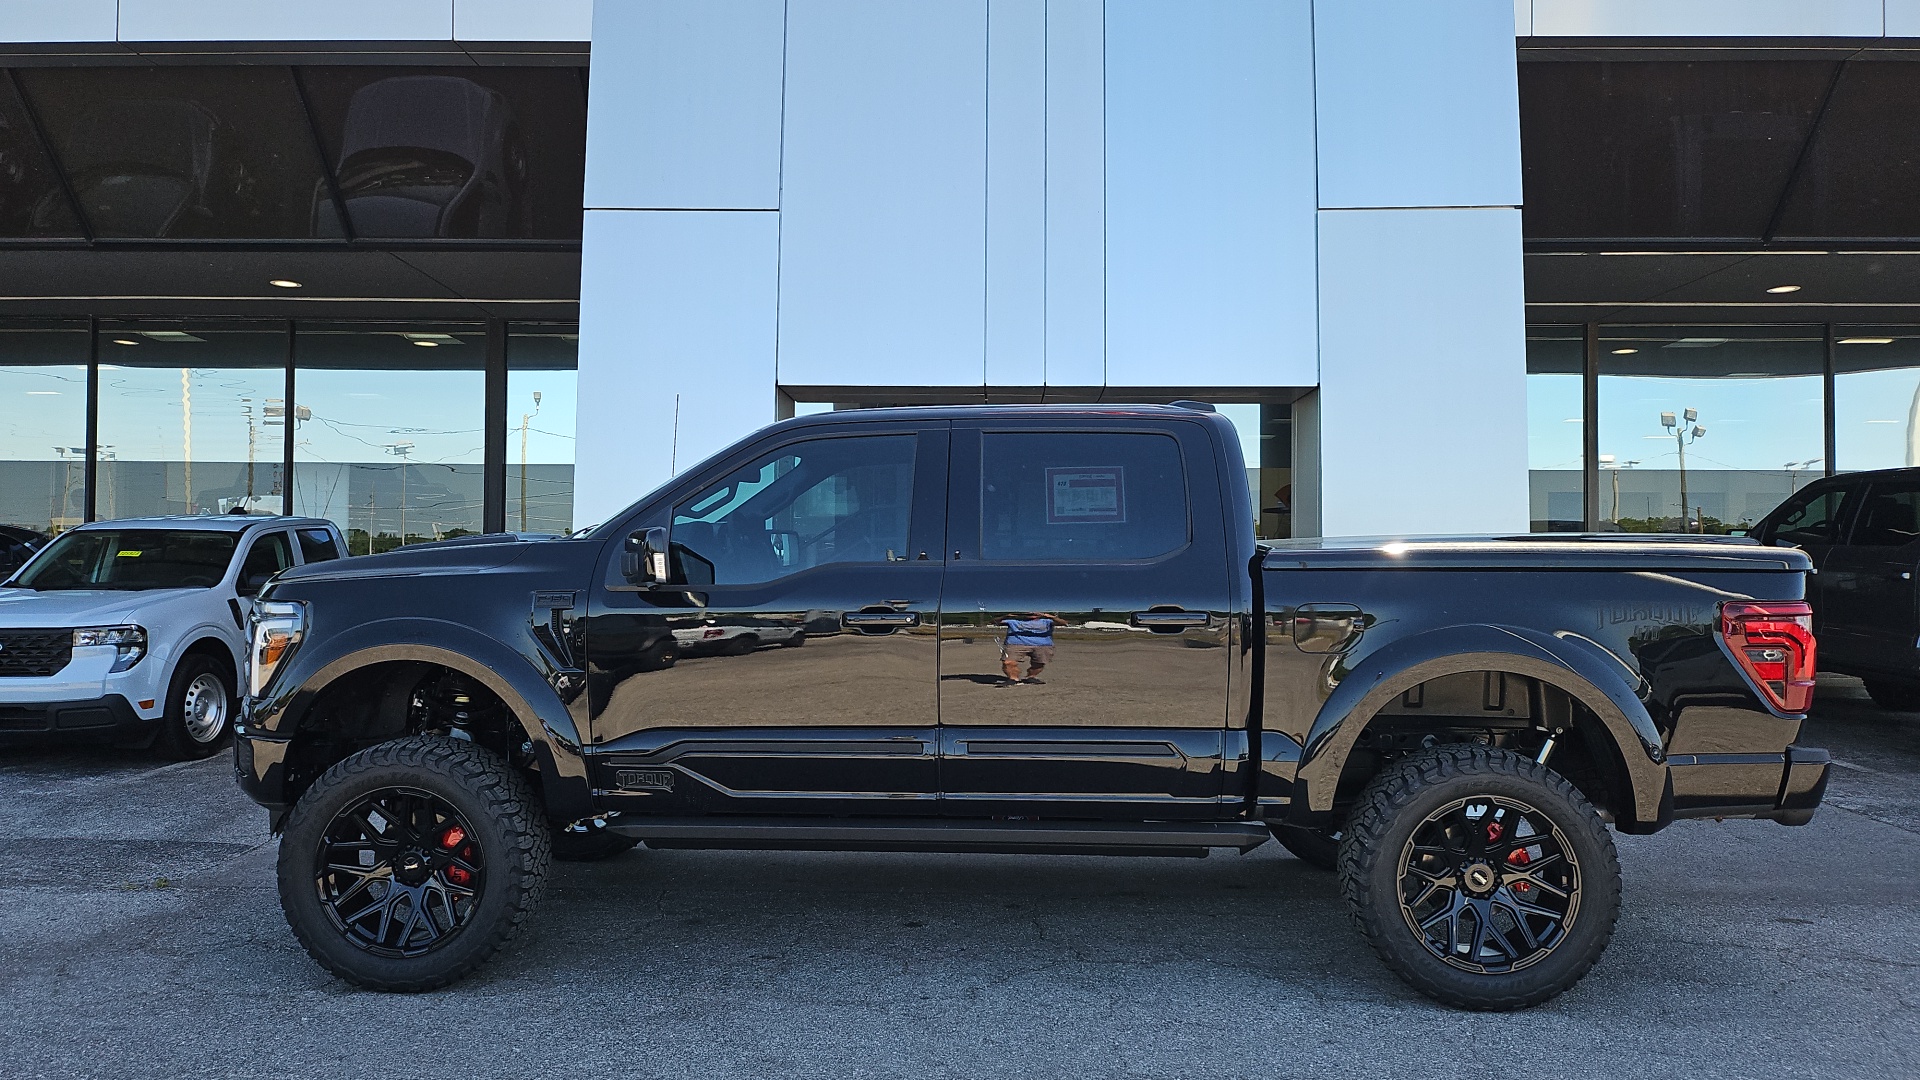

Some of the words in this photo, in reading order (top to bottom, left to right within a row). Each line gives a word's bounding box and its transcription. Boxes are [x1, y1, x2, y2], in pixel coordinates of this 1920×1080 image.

[536, 594, 571, 606] F-150
[1588, 601, 1705, 635] TORQUE
[618, 772, 672, 787] TORQUE
